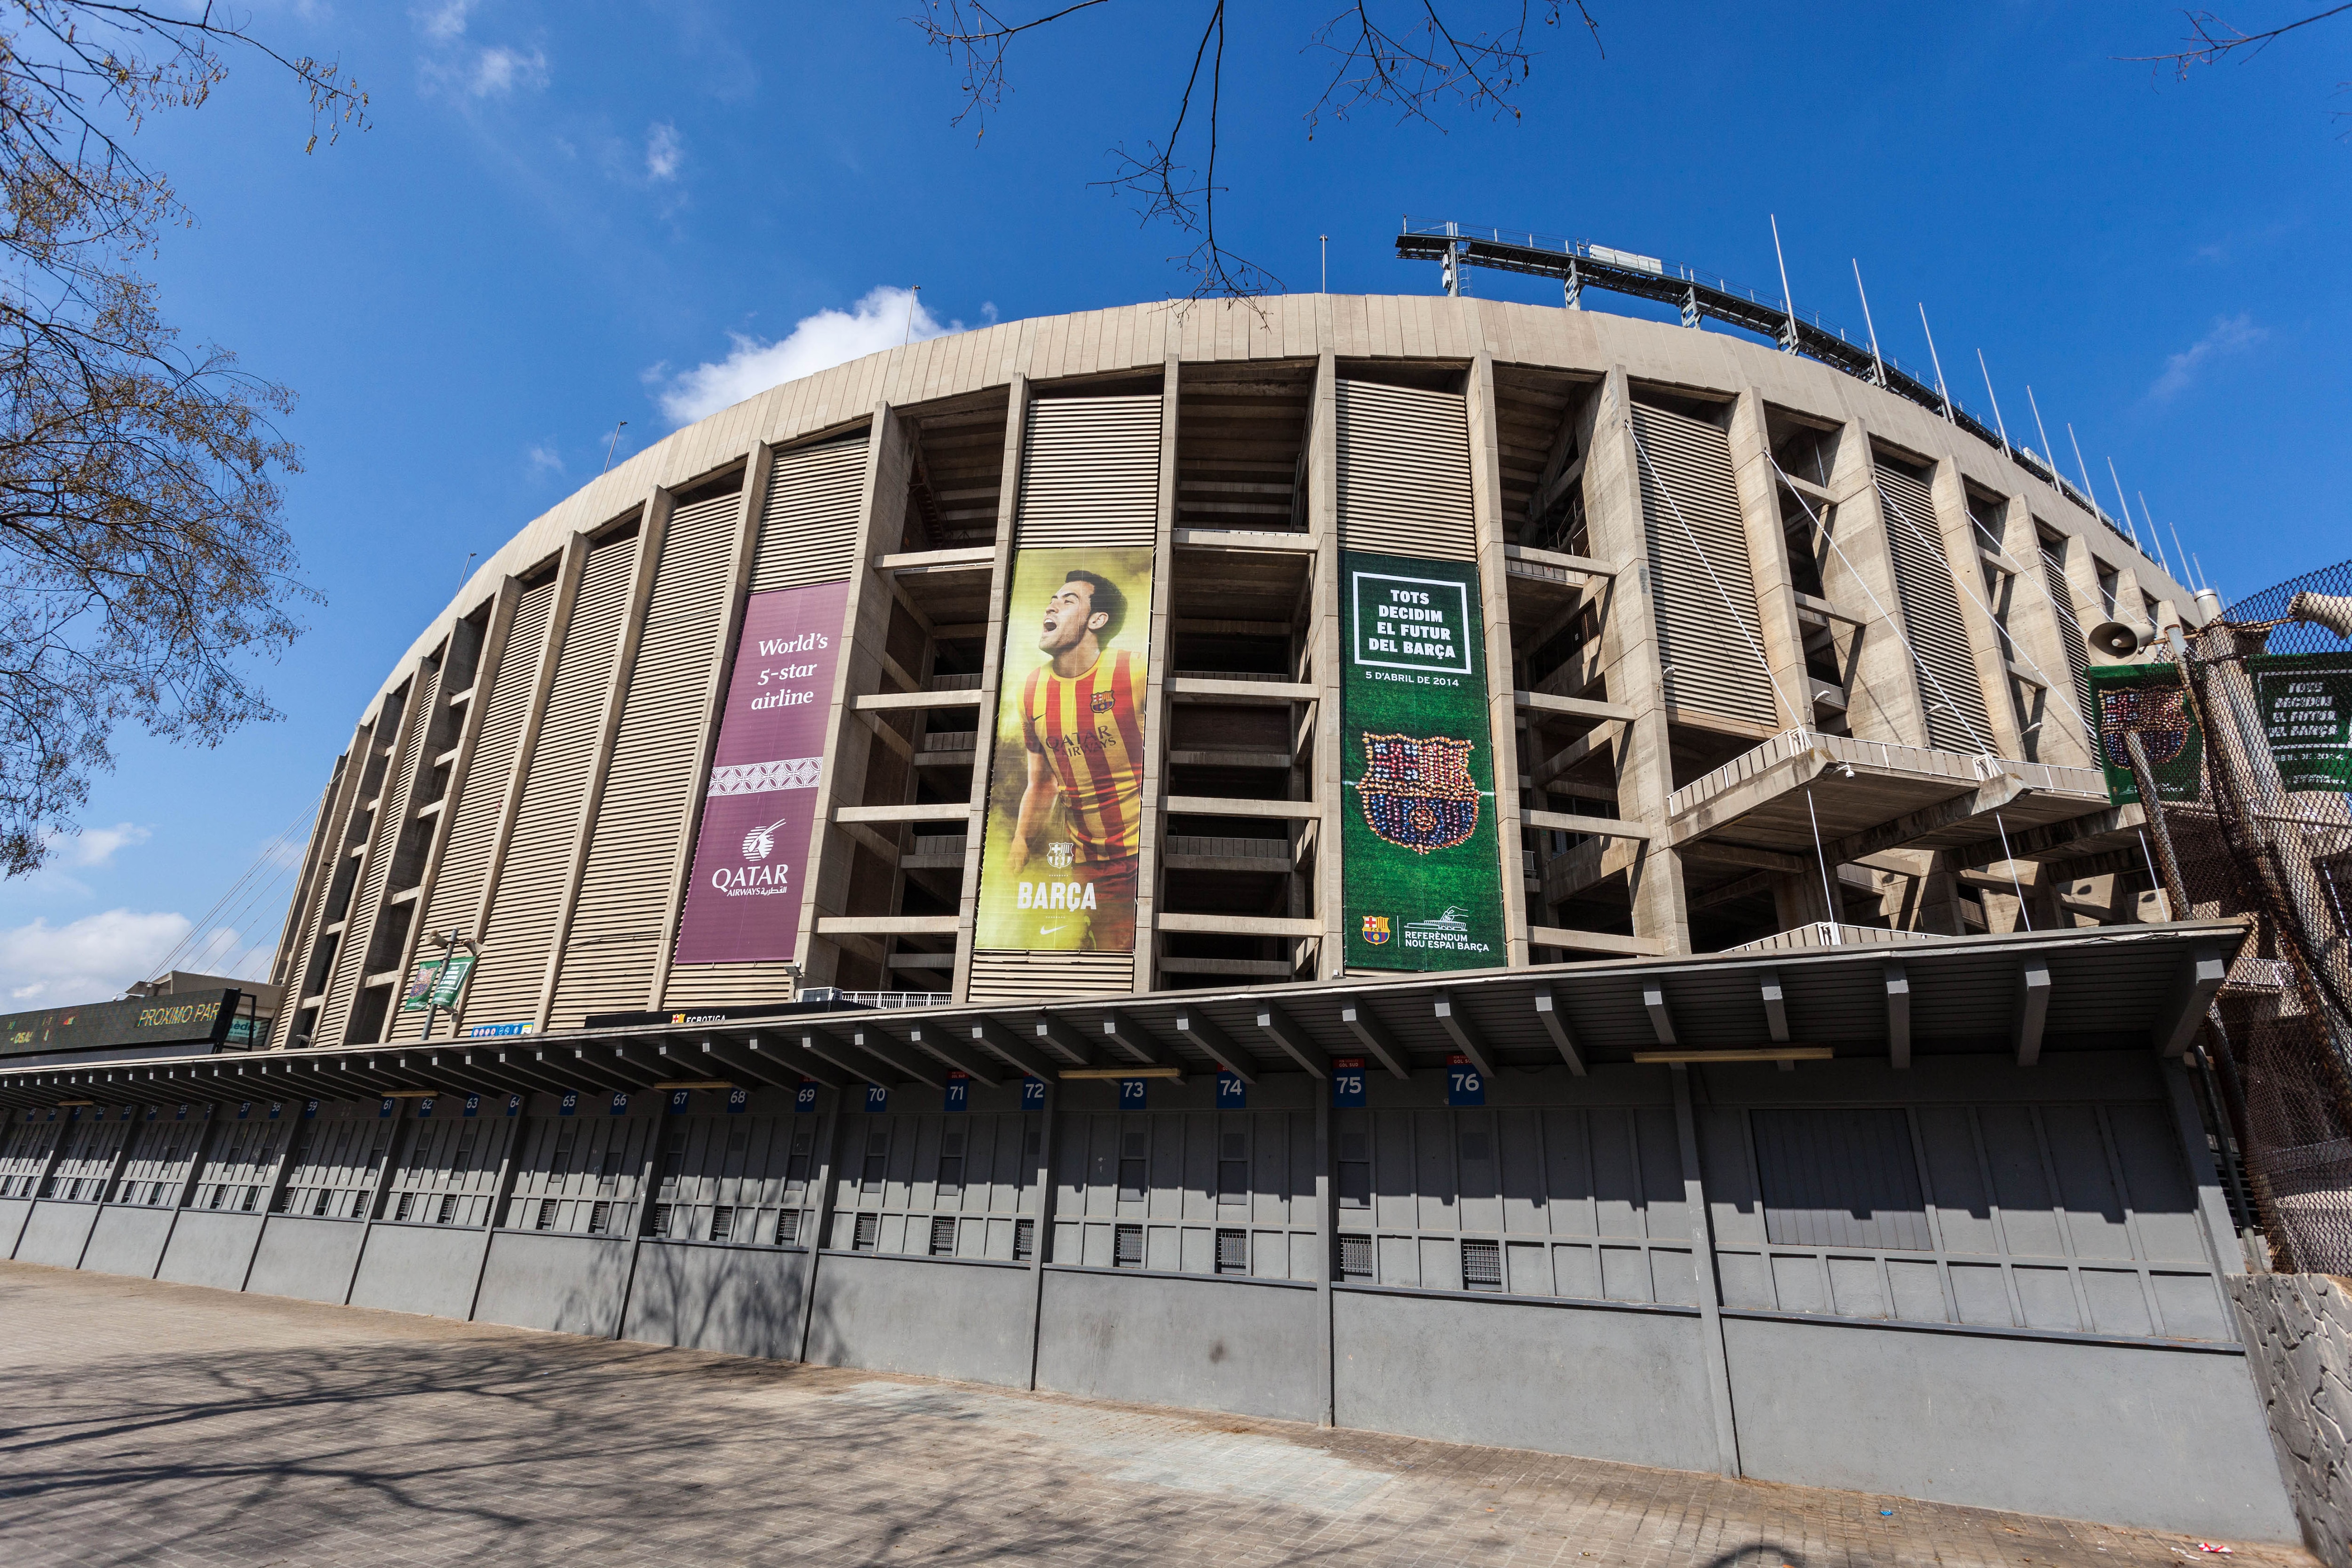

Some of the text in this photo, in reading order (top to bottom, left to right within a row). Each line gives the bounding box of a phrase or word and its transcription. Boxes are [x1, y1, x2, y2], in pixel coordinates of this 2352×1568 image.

[1390, 589, 1430, 605] TOTS
[1378, 605, 1443, 623] DECIDIM
[1377, 621, 1451, 640] EL FUTUR
[758, 632, 829, 657] World's
[1368, 637, 1456, 660] DEL BARÇA
[757, 663, 818, 686] 5-star
[1365, 671, 1459, 687] 5 D'ABRIL DE 2014
[751, 689, 814, 710] airline
[1045, 725, 1112, 752] QATAR
[1062, 737, 1117, 757] AIRWAYS
[712, 864, 789, 893] QATAR
[726, 887, 761, 897] AIRWAYS
[1017, 882, 1097, 912] BARÇA
[1405, 931, 1468, 942] REFERÈNDUM
[1405, 938, 1490, 953] NOU ESPAI BARÇA
[137, 1005, 194, 1027] PROXIMO
[1124, 1082, 1143, 1097] 73
[1221, 1080, 1242, 1095] 74
[1337, 1077, 1361, 1093] 75
[1452, 1074, 1479, 1091] 76
[674, 1092, 687, 1104] 67
[731, 1091, 745, 1103] 68
[799, 1089, 814, 1102] 69
[870, 1088, 885, 1101] 70
[951, 1086, 963, 1099] 71
[1026, 1083, 1043, 1098] 72
[241, 1101, 251, 1112] 57
[272, 1102, 281, 1111] 58
[308, 1102, 318, 1111] 59
[384, 1100, 392, 1109] 61
[422, 1099, 432, 1109] 62
[467, 1098, 478, 1108] 63
[563, 1096, 575, 1106] 65
[614, 1095, 626, 1106] 66
[179, 1105, 188, 1114] 55
